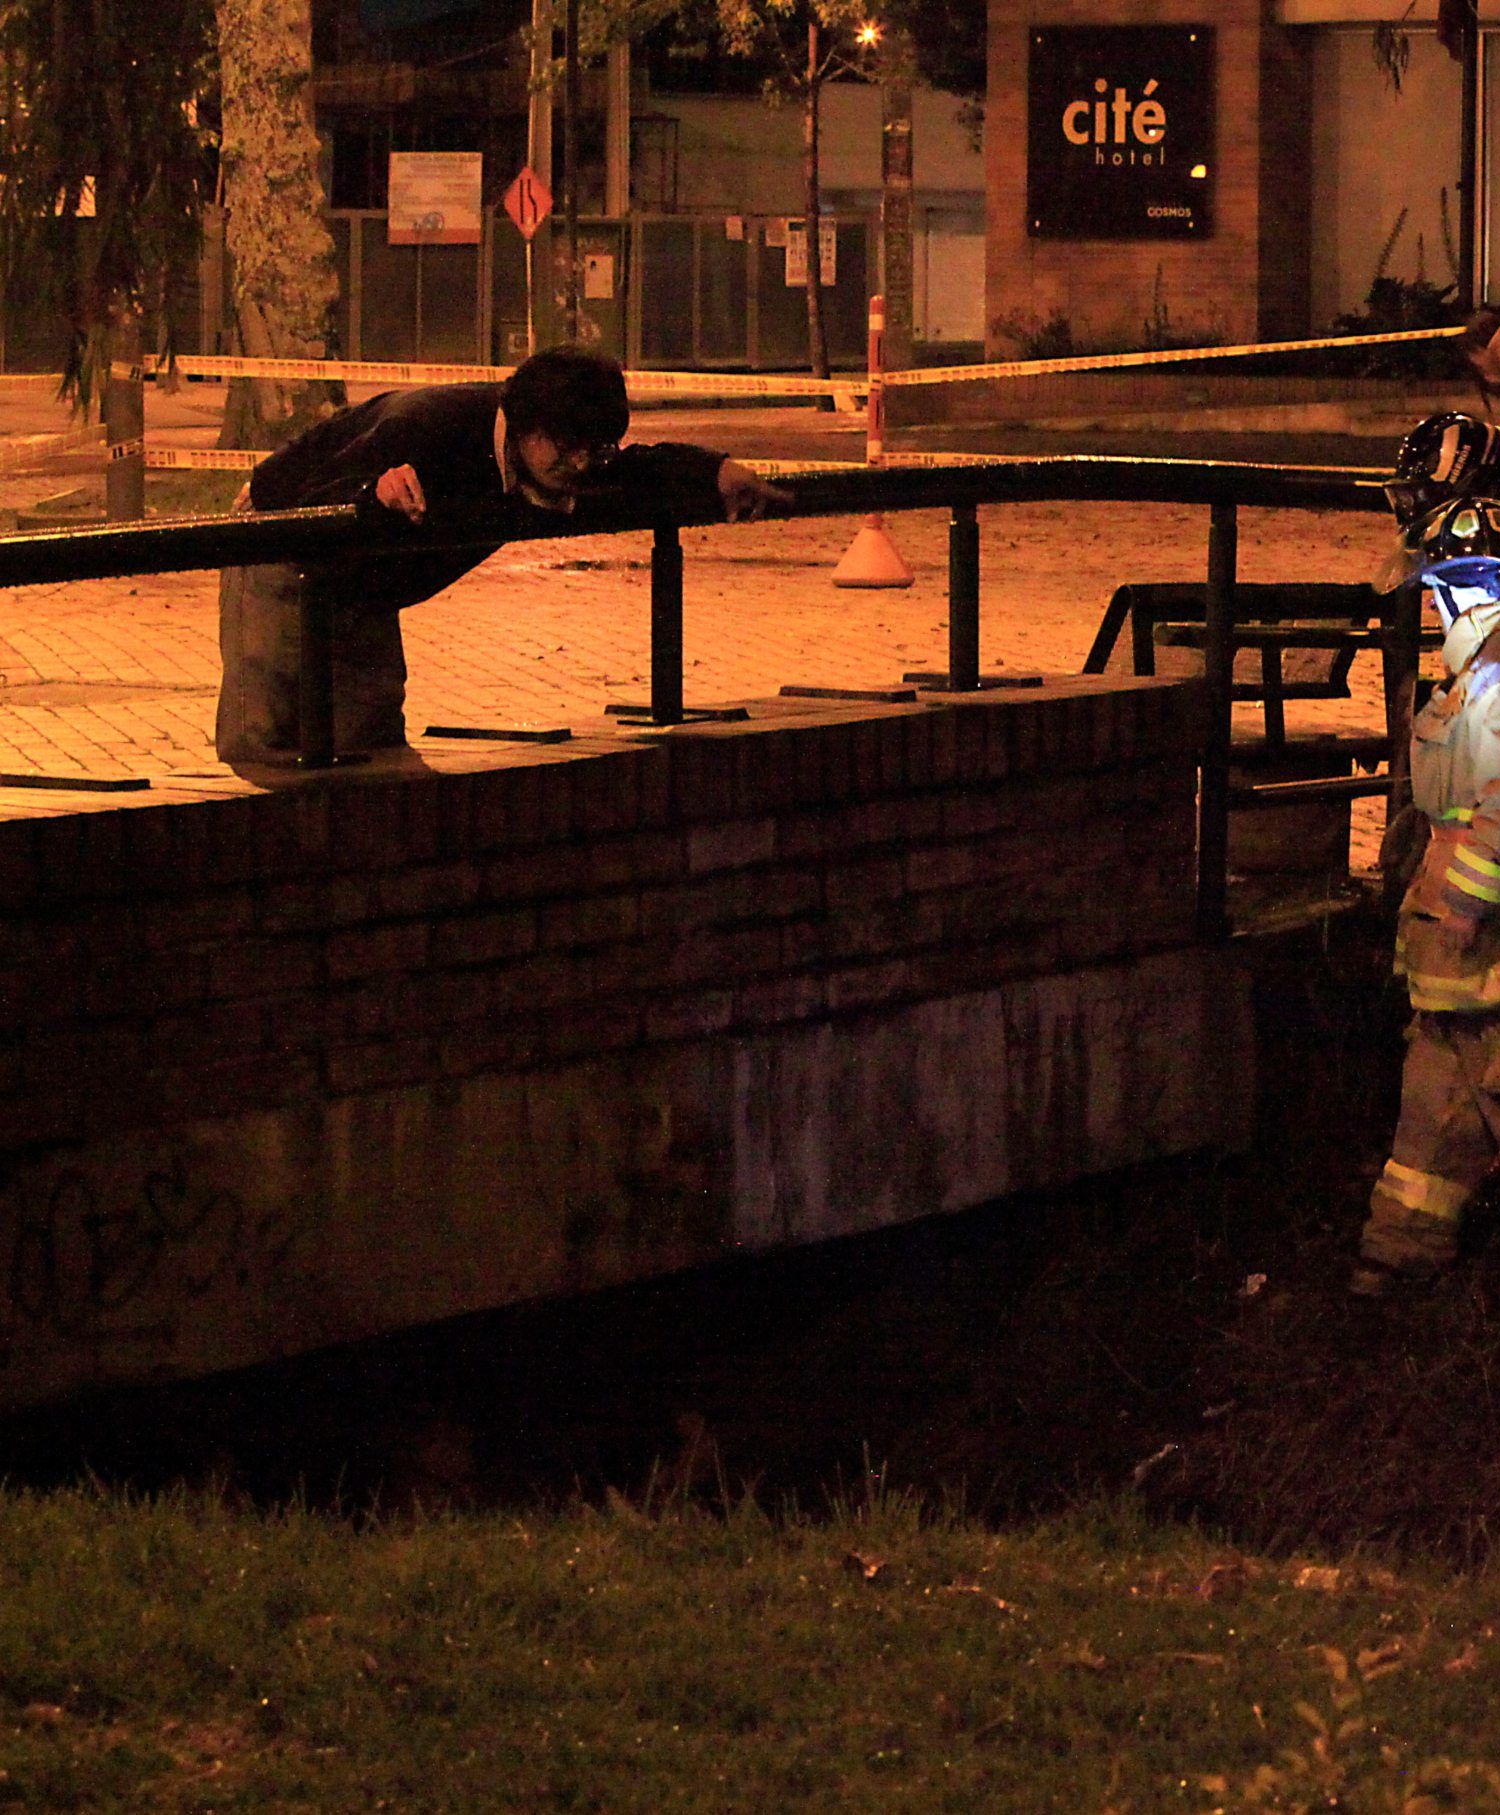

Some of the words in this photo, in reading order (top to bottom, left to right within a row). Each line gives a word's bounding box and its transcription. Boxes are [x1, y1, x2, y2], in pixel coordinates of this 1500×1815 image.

[1062, 78, 1167, 145] cité
[1095, 146, 1165, 166] hotel
[1147, 206, 1192, 218] COSMOS
